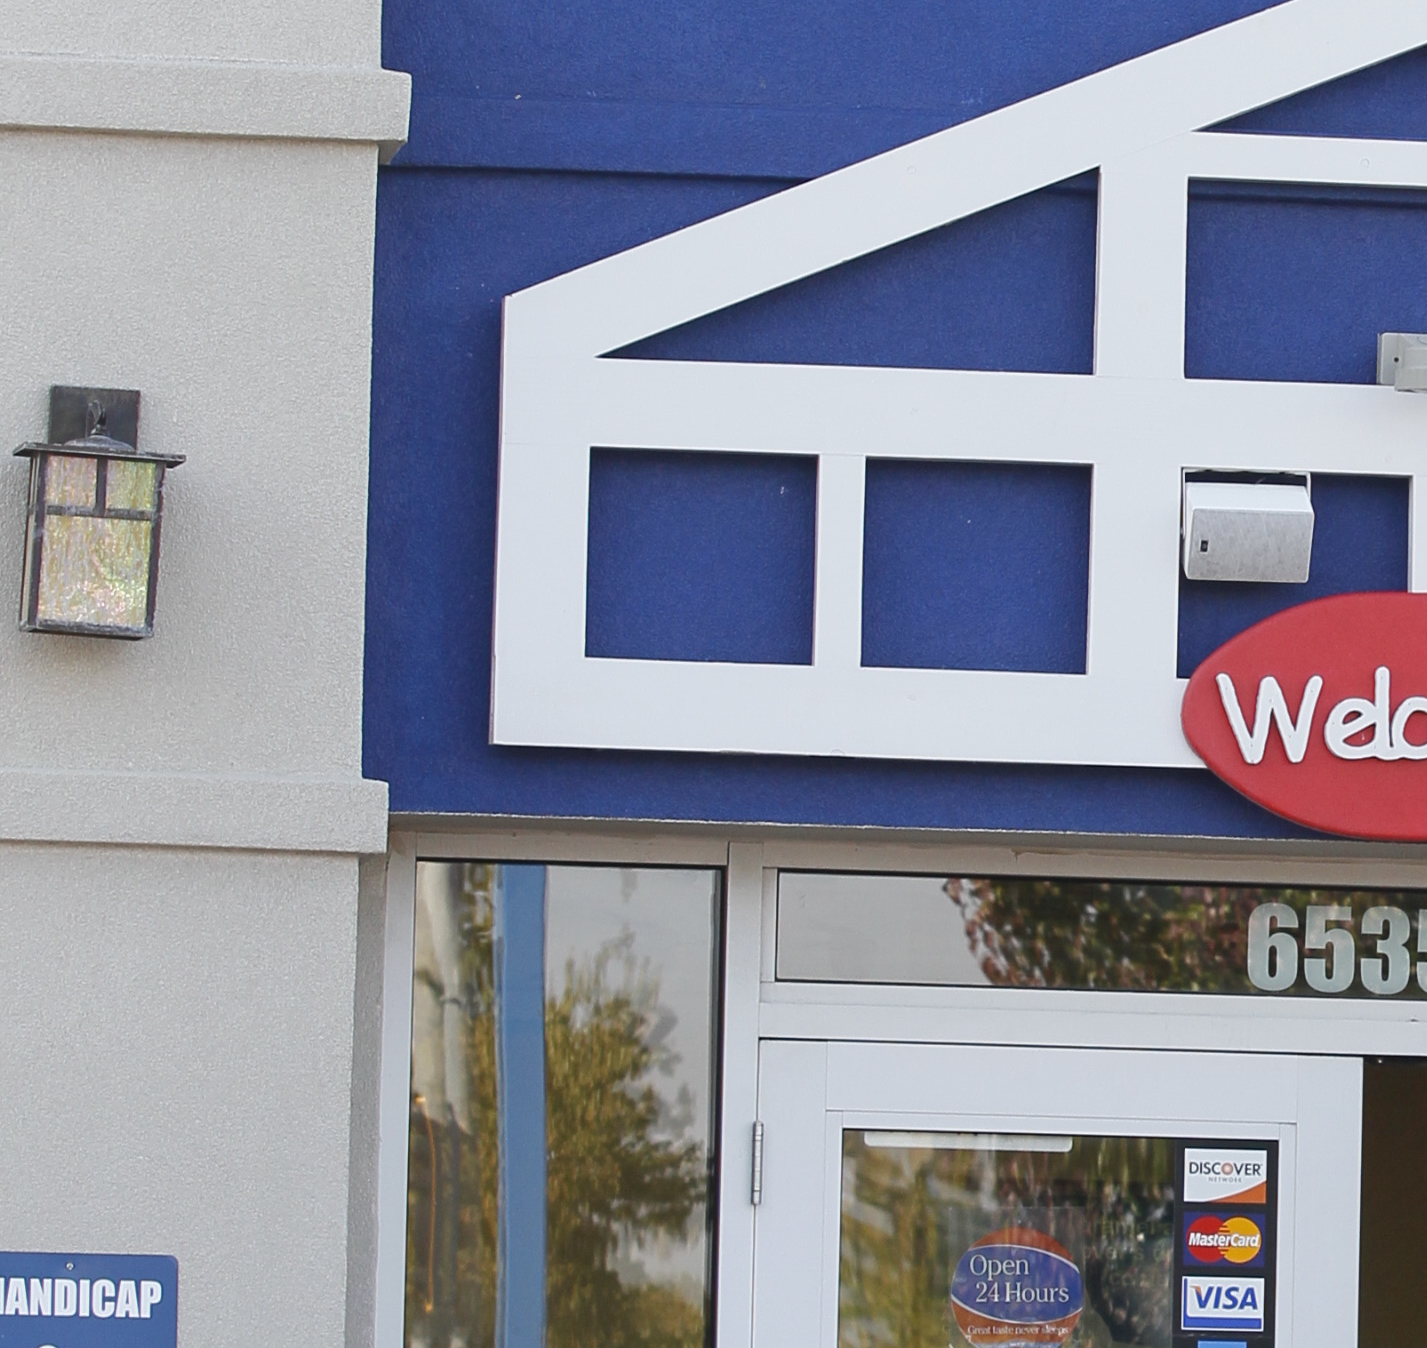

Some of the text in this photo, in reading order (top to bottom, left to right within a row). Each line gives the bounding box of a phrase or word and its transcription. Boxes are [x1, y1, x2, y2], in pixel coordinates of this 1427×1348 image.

[1188, 1161, 1263, 1176] DISCOVER
[1187, 1232, 1261, 1248] MasterCard
[969, 1254, 1029, 1281] Open
[0, 1277, 163, 1319] ANDICAP
[975, 1281, 1070, 1303] 24 Hours
[1190, 1285, 1258, 1310] VISA
[967, 1324, 1069, 1336] Great taste never sleeps
